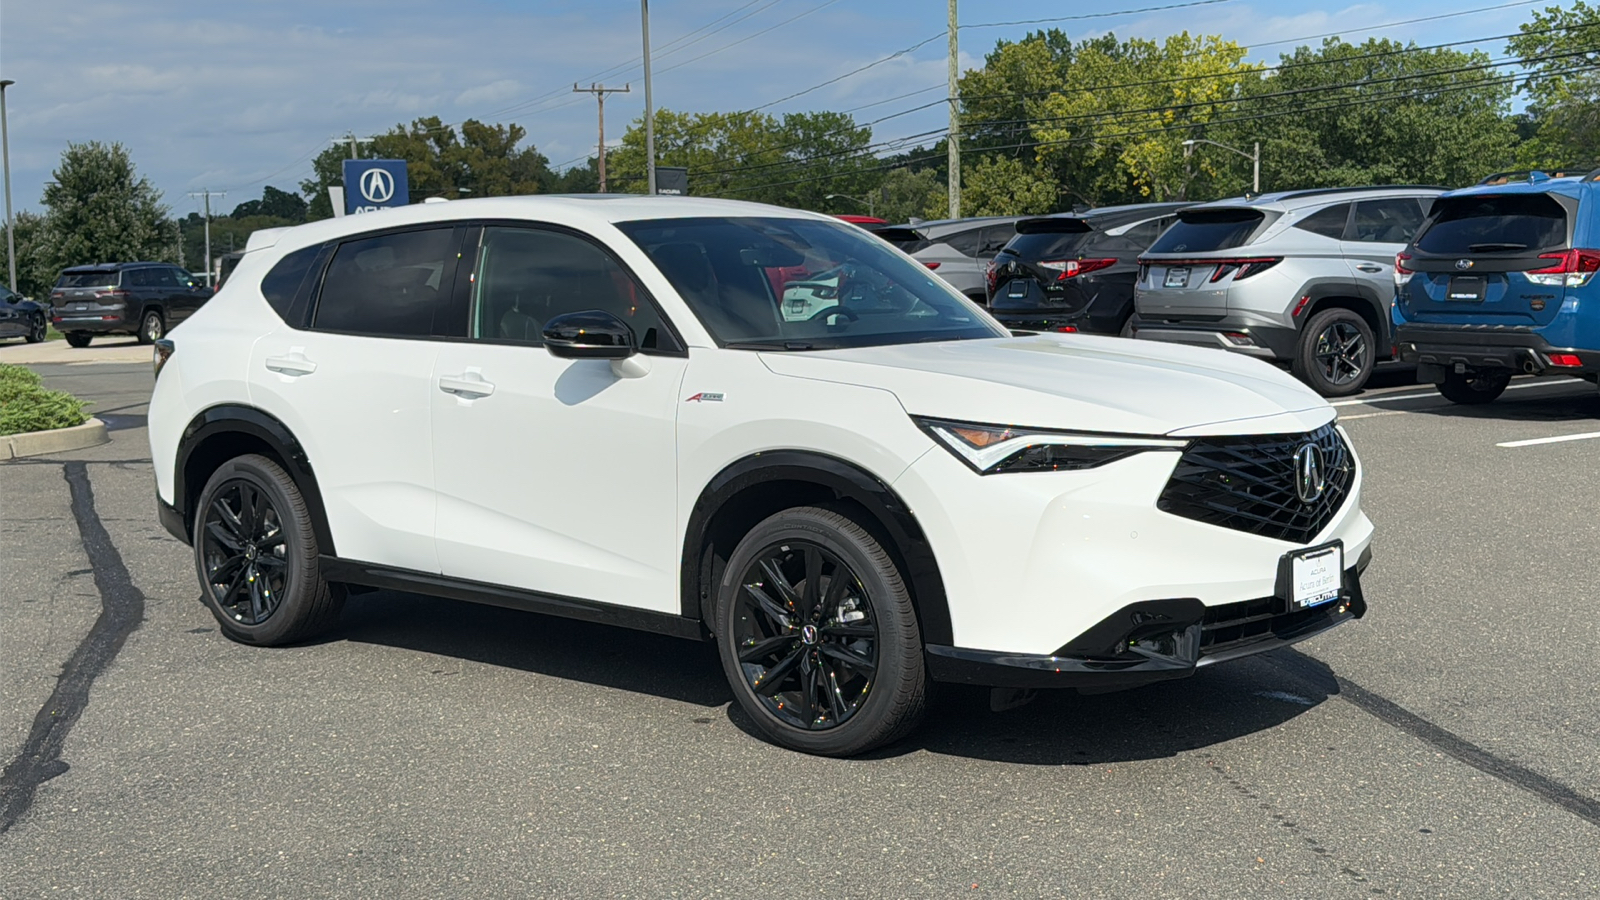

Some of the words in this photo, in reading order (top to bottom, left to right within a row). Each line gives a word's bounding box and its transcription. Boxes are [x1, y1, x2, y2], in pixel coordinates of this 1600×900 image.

[1310, 568, 1326, 576] ACURA
[1300, 581, 1314, 591] Acura
[1316, 578, 1321, 586] of
